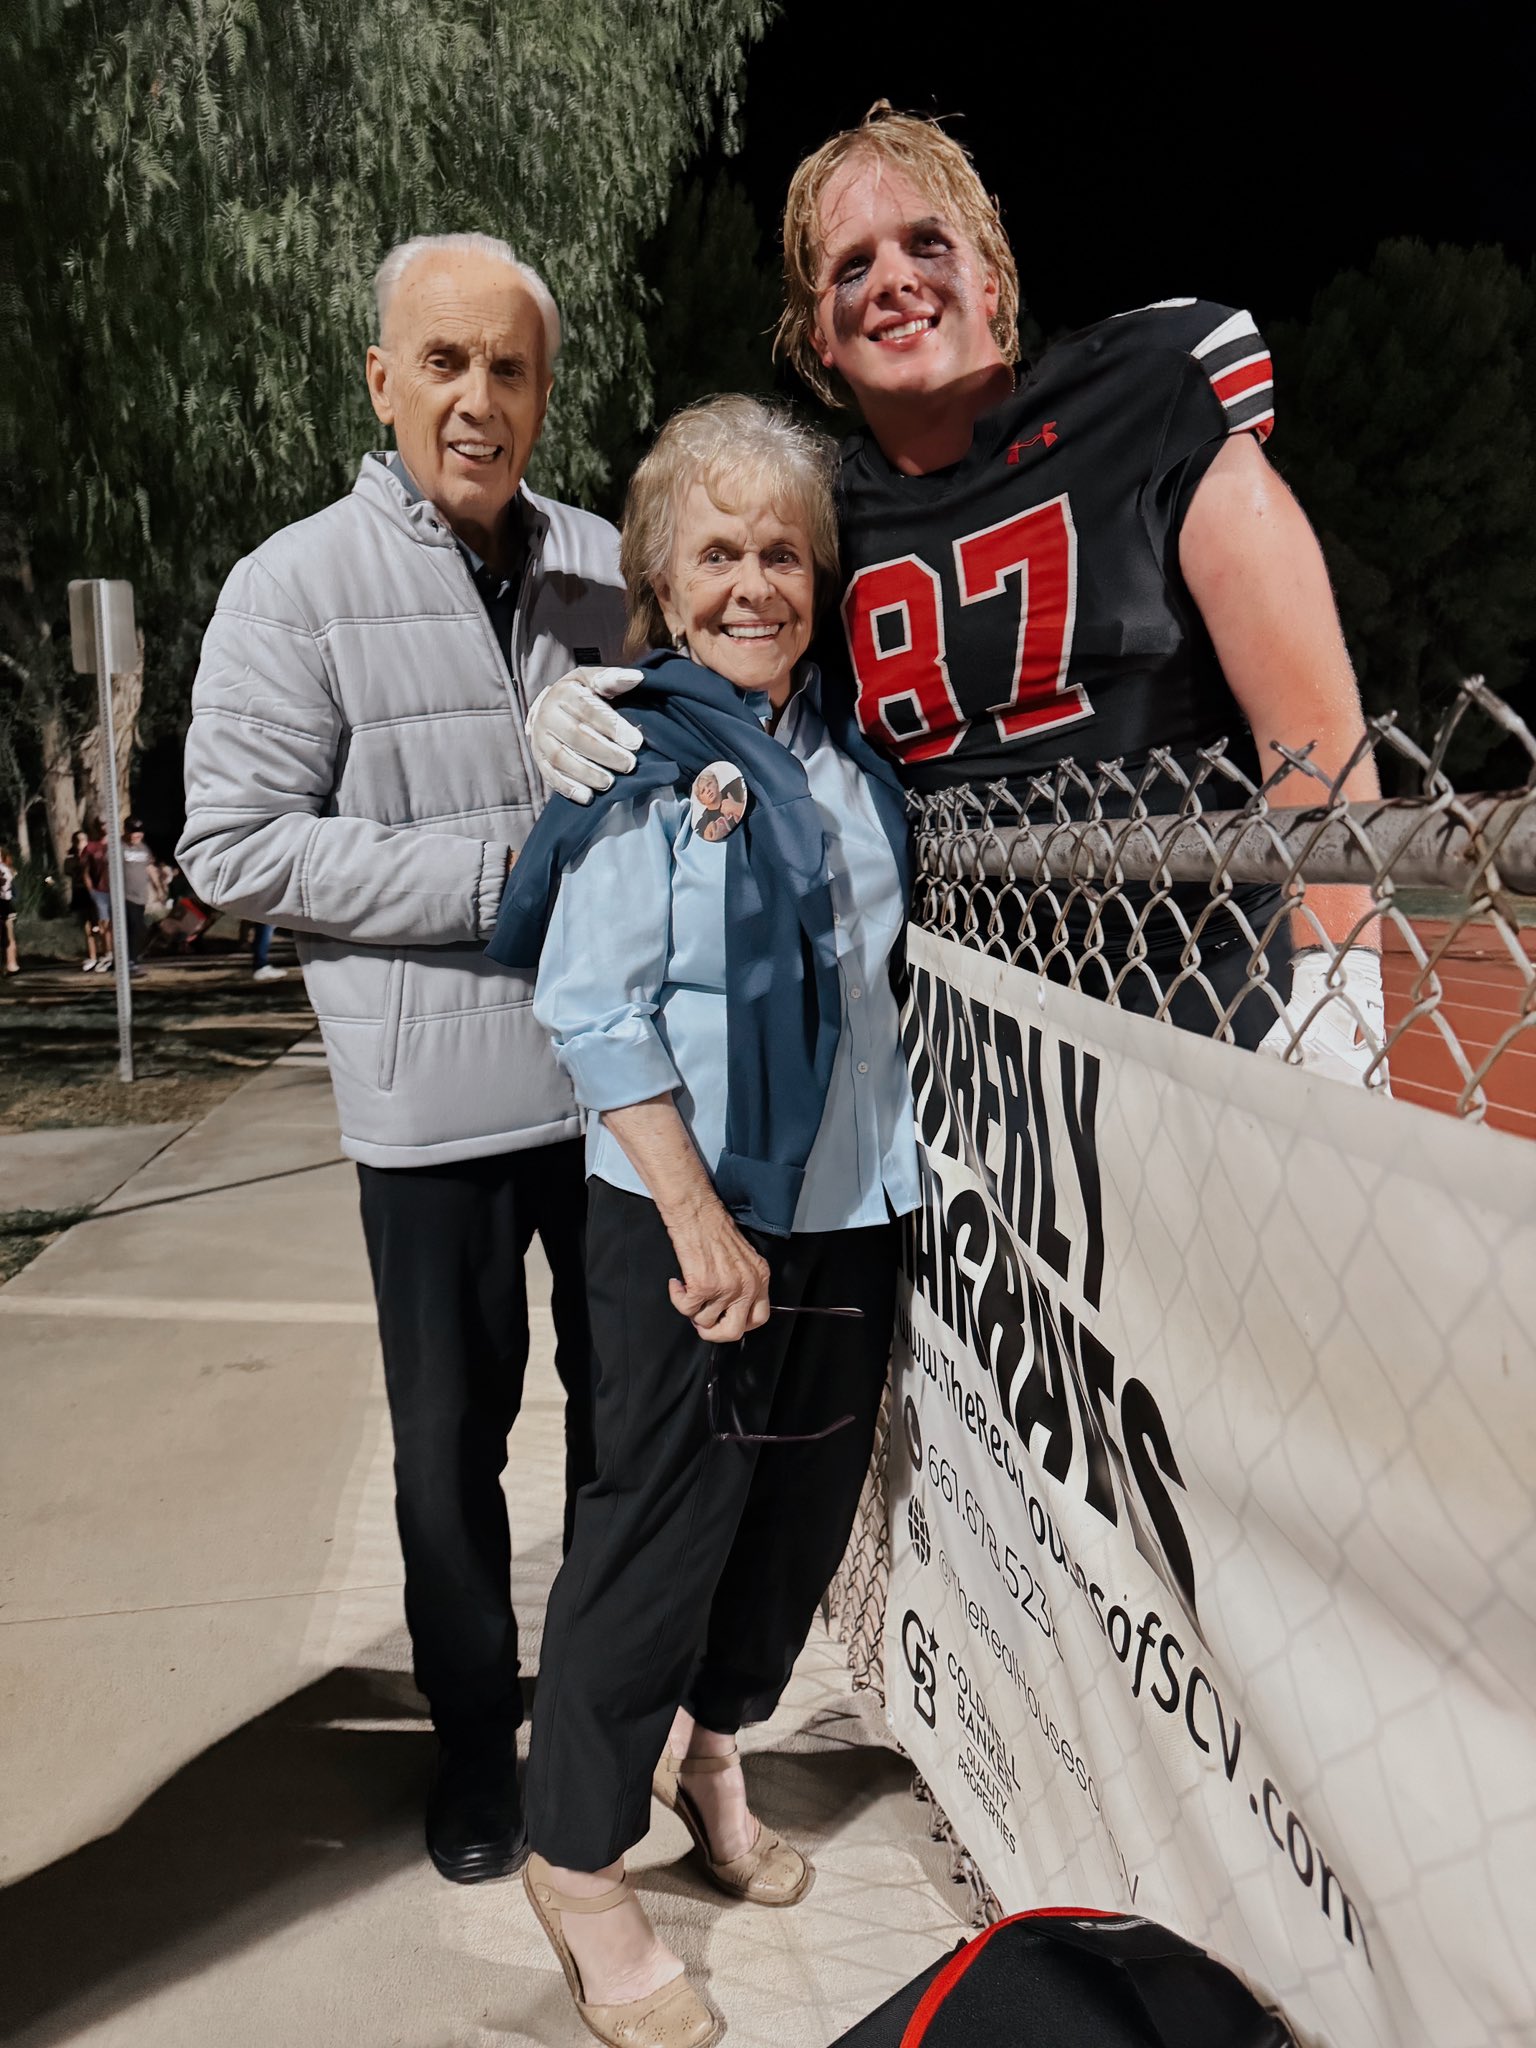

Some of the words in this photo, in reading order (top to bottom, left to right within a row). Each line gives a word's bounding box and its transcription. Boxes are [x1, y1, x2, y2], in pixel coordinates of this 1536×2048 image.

[840, 492, 1095, 765] 87
[948, 1652, 1021, 1792] COLDWELL
[957, 1692, 1014, 1798] BANKER
[958, 1753, 1016, 1854] PROPERTIES
[966, 1746, 1008, 1815] QUALITY
